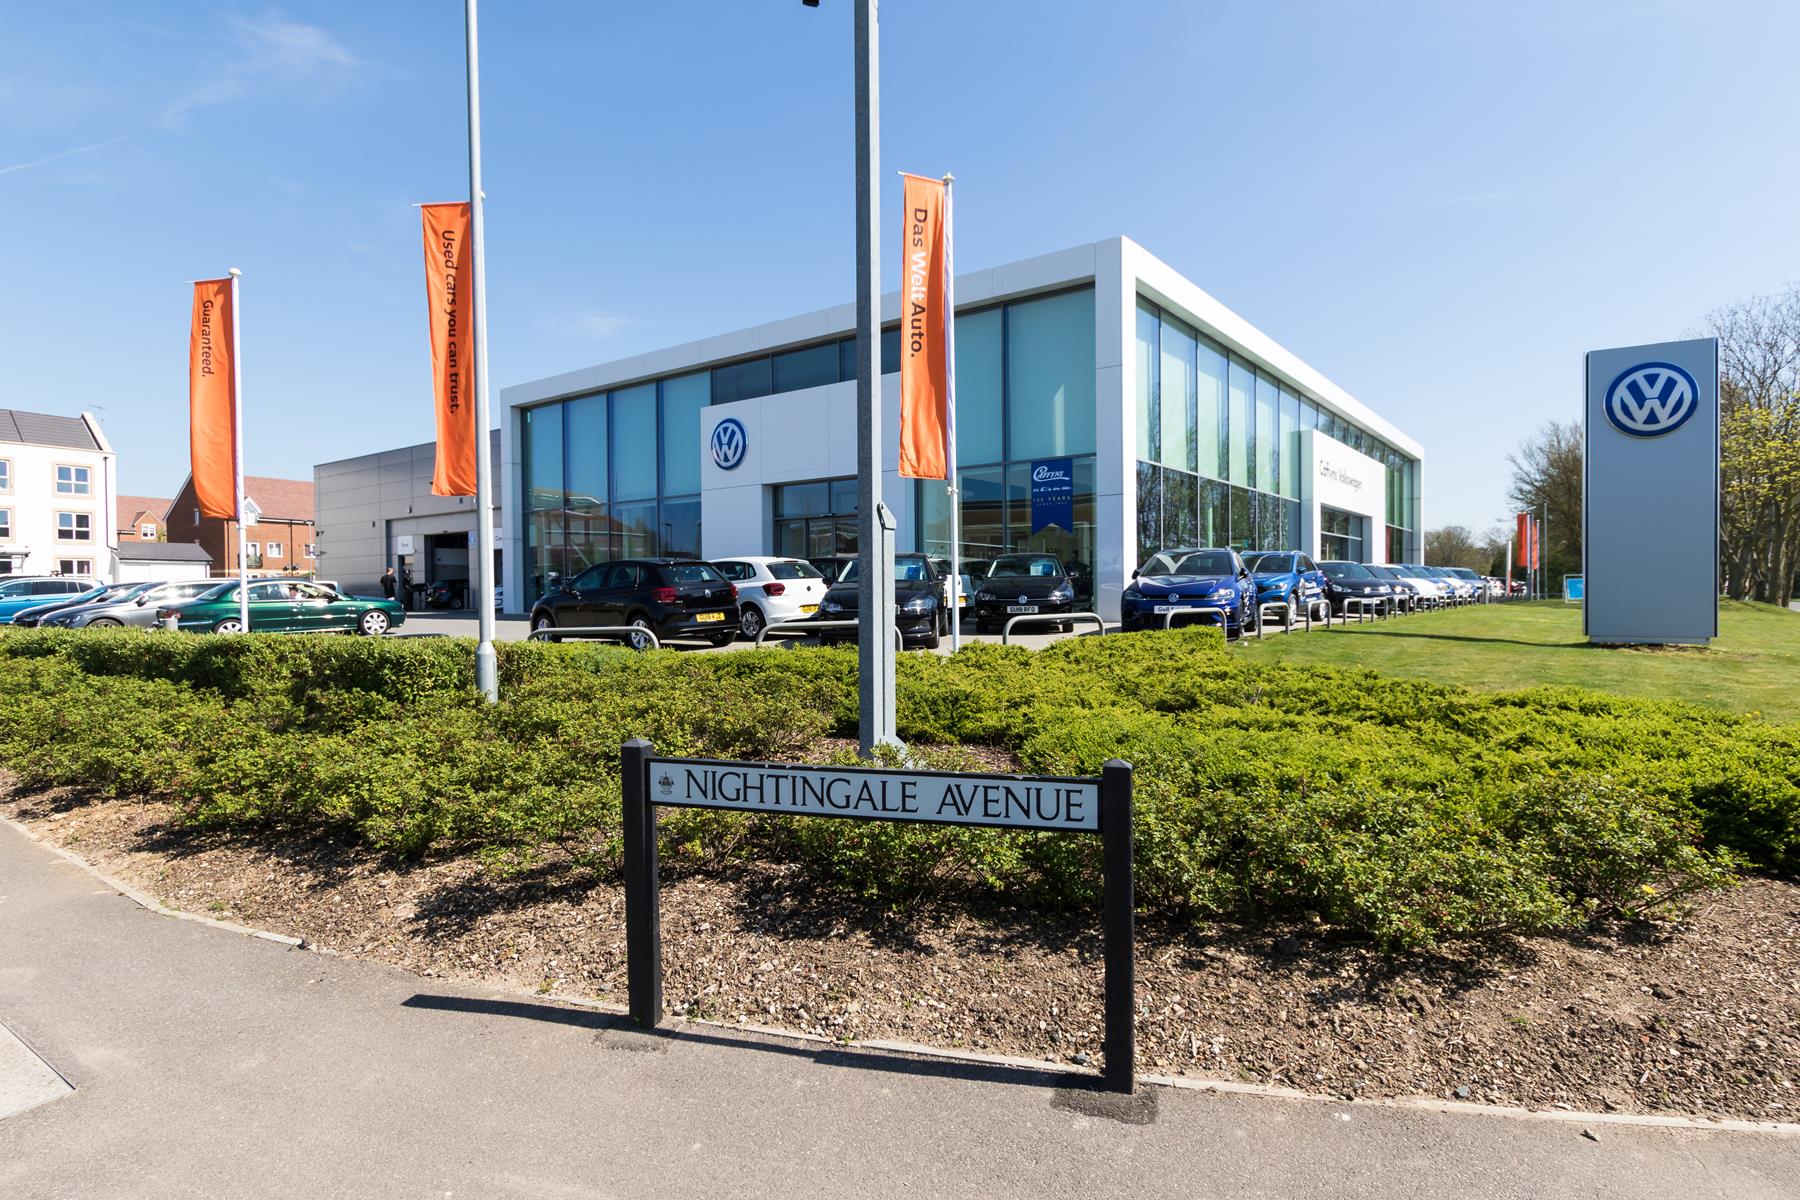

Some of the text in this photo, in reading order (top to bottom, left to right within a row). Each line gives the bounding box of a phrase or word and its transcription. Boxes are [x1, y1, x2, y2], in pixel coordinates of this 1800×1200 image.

[912, 208, 928, 247] Das
[202, 300, 214, 378] Guaranteed.
[441, 230, 460, 414] Used cars you can trust.
[684, 768, 1085, 822] NIGHTINGALE AVENUE
